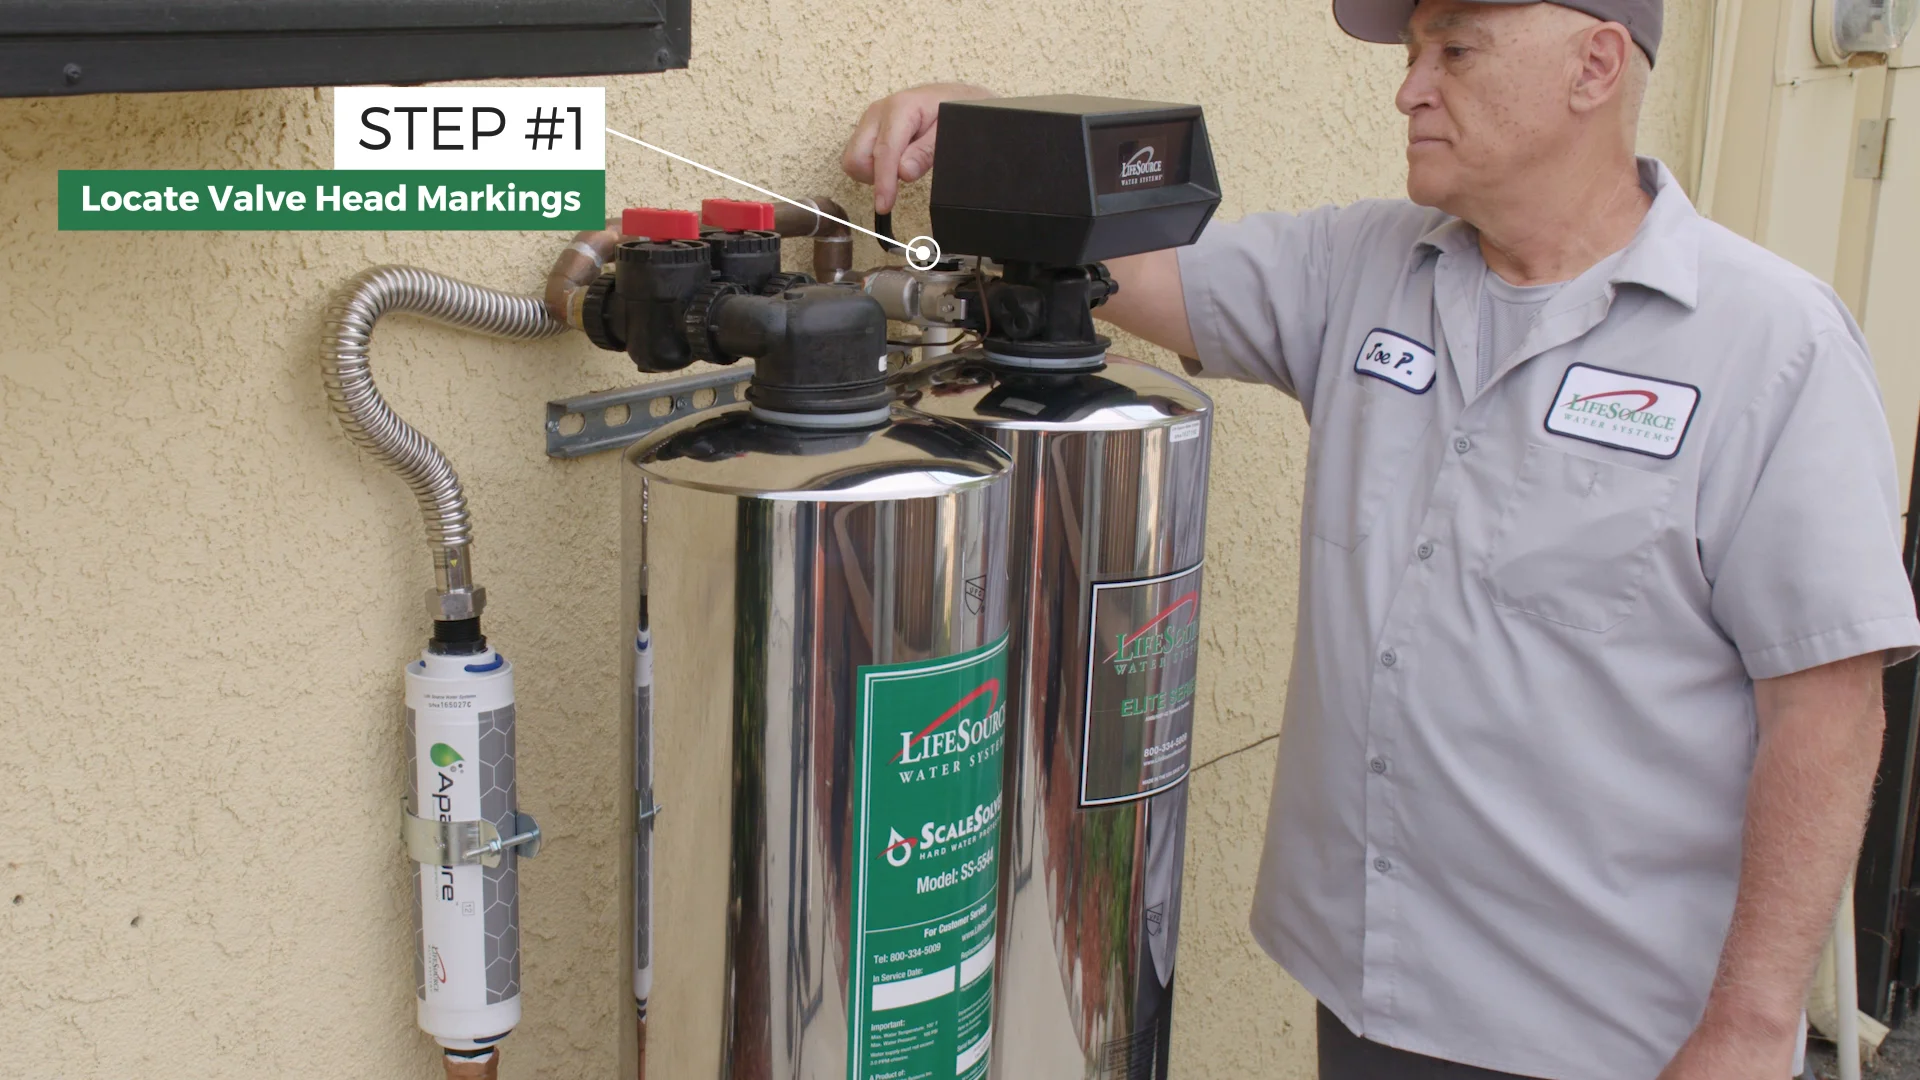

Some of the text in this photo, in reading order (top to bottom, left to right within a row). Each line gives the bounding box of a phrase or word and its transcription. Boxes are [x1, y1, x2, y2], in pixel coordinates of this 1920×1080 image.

[1121, 178, 1138, 186] WATER
[1366, 342, 1415, 375] Joe P.
[1564, 413, 1605, 429] WATER
[1114, 660, 1166, 675] WATER
[1121, 693, 1167, 717] ELITE
[899, 700, 1006, 765] LIFESOURC
[899, 762, 961, 784] WATER
[919, 847, 947, 860] HARD
[951, 834, 977, 852] WATER
[916, 847, 994, 894] Model: SS-5544
[924, 903, 987, 938] For Customer Service
[873, 942, 941, 964] Tel: 800-334-5009
[873, 968, 923, 983] In Service Date:
[871, 1019, 905, 1032] Important:
[875, 1071, 897, 1080] Product
